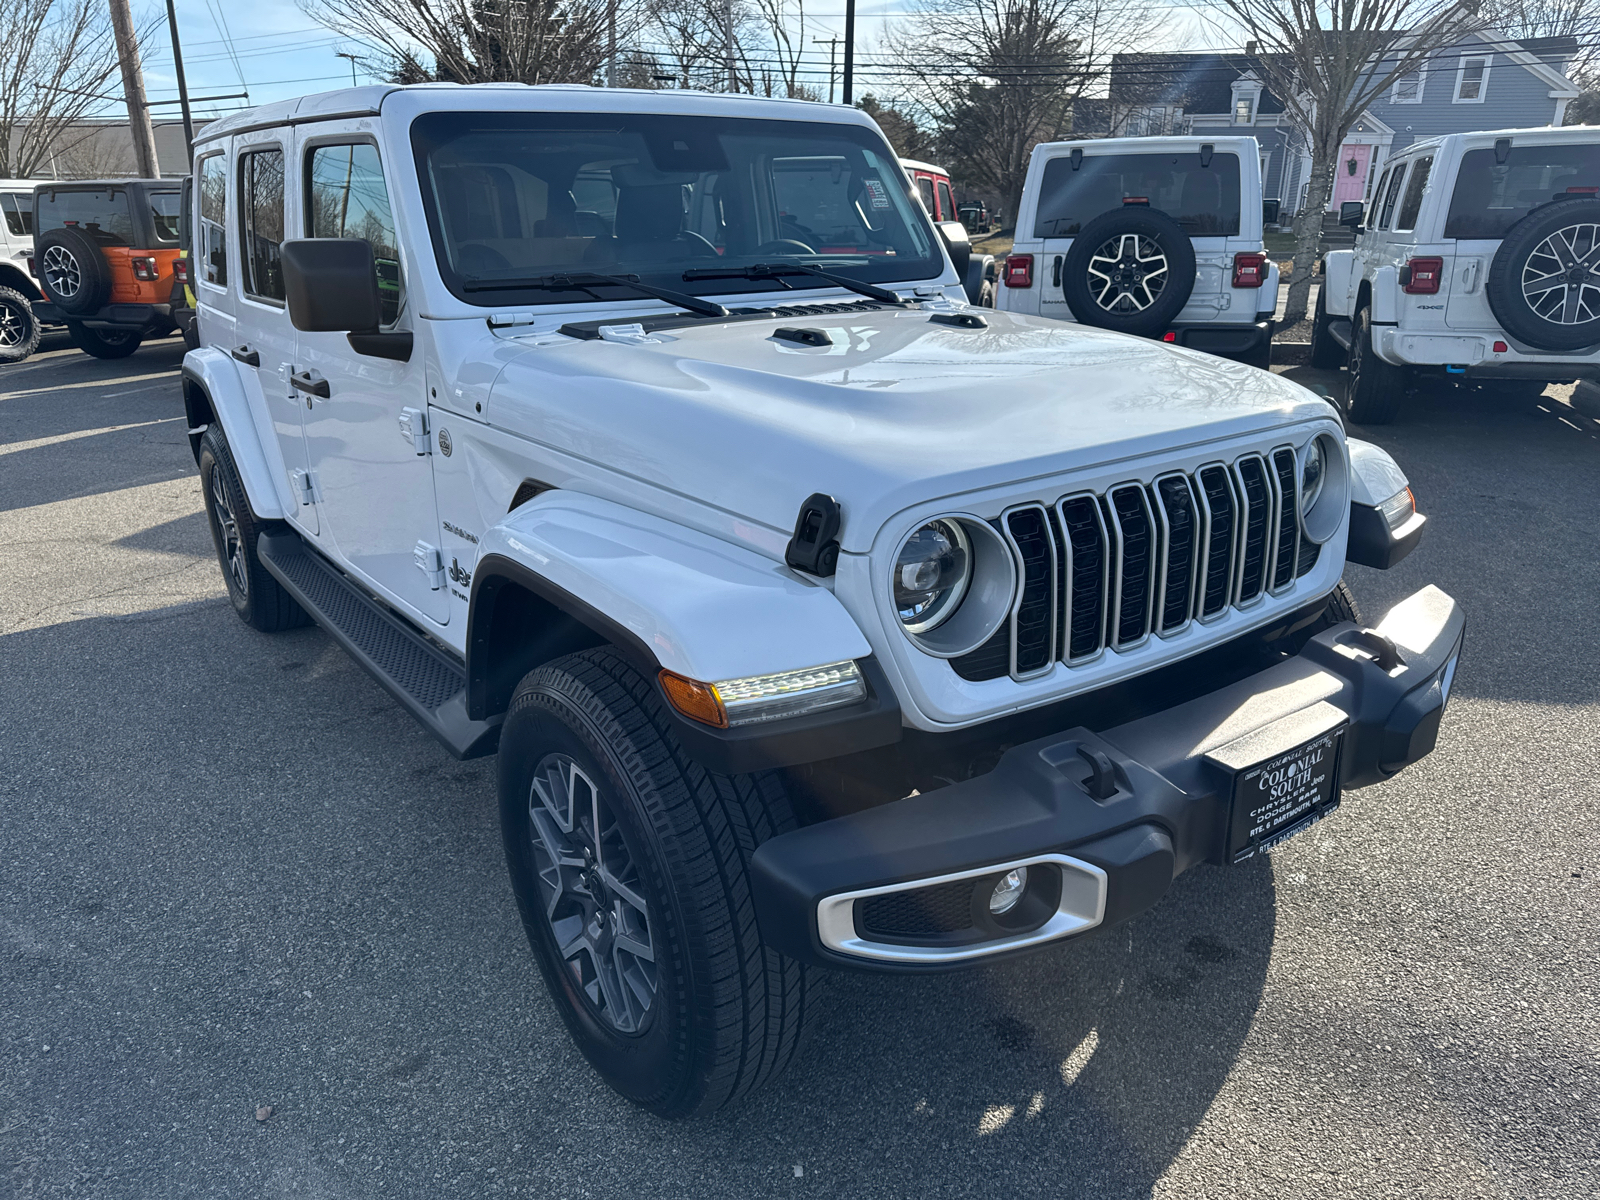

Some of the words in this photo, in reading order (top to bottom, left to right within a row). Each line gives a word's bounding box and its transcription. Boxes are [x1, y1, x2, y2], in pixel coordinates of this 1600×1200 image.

[1259, 749, 1323, 790] COLONIAL
[1269, 768, 1312, 800] SOUTH
[1250, 787, 1305, 817] CHRYSLER
[1311, 774, 1325, 786] Jeep
[1257, 802, 1292, 823] DODGE
[1299, 787, 1318, 802] RAM
[1250, 824, 1265, 837] RTE.
